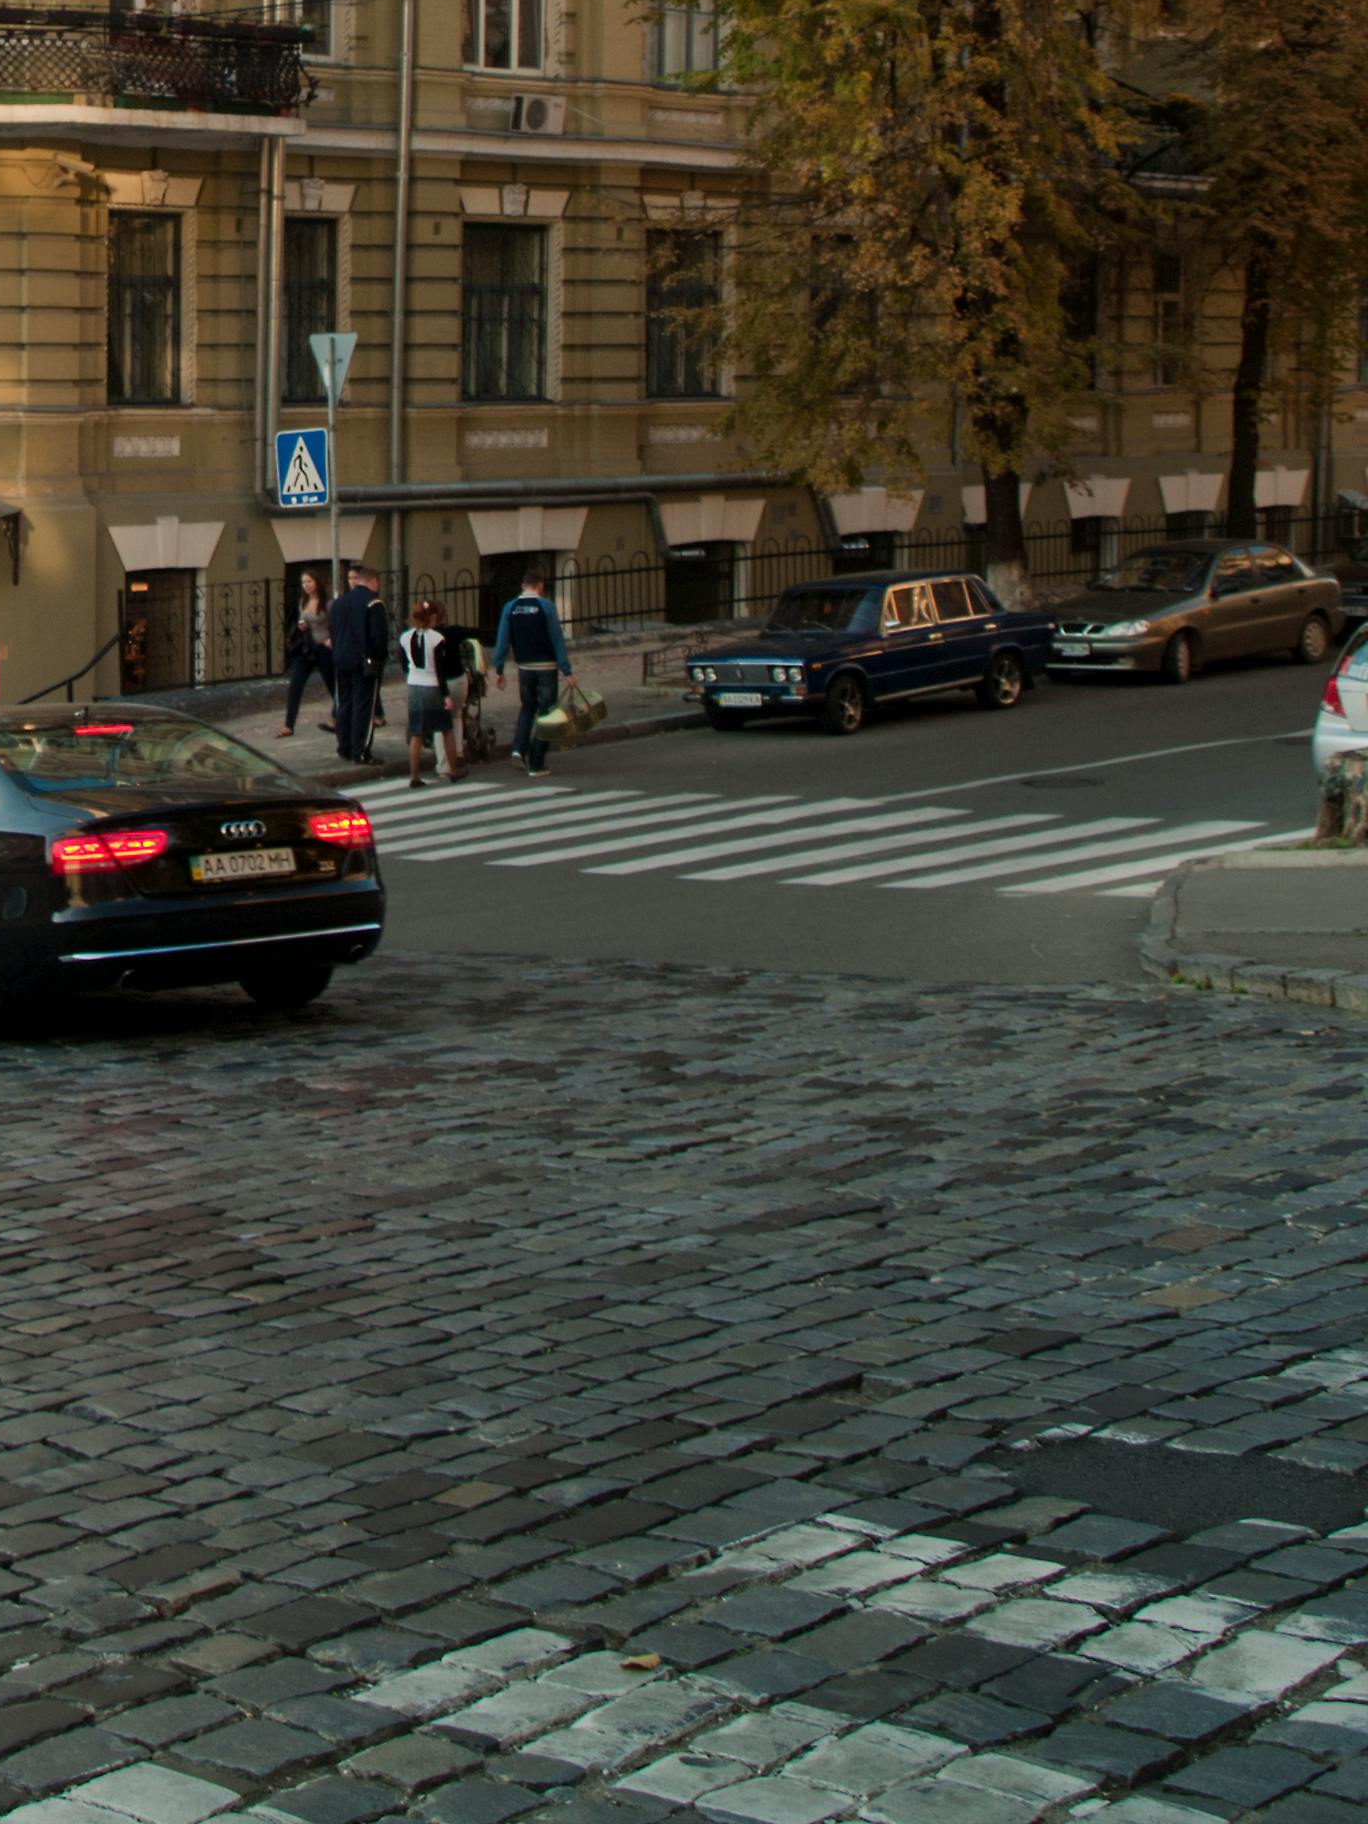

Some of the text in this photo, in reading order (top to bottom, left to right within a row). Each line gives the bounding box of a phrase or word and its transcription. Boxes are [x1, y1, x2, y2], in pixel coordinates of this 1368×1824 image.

[204, 851, 291, 876] AA 0702 MH
